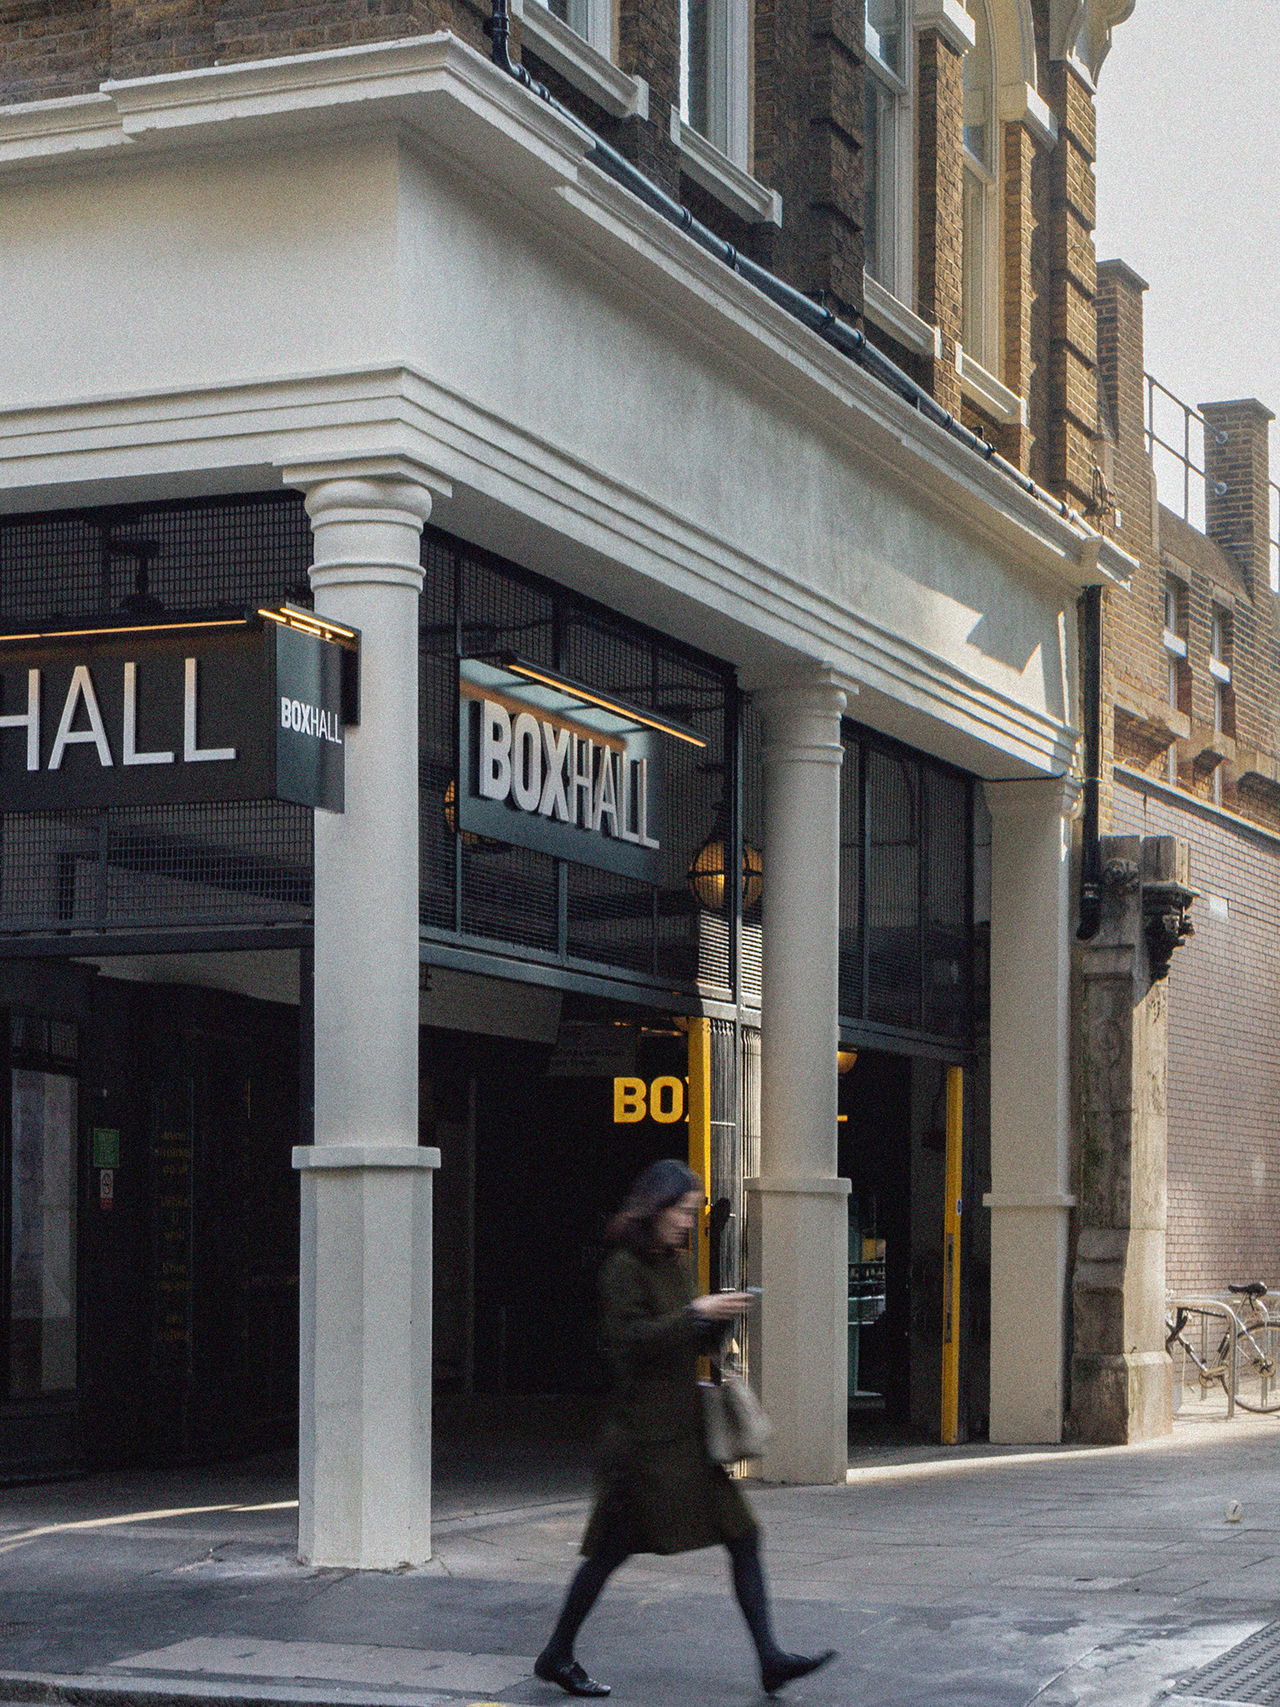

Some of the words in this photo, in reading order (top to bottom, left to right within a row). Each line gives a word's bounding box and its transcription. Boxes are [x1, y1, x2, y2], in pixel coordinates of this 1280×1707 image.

[281, 696, 342, 744] BOXHALL
[479, 699, 660, 849] BOXHALL
[613, 1075, 689, 1124] BO
